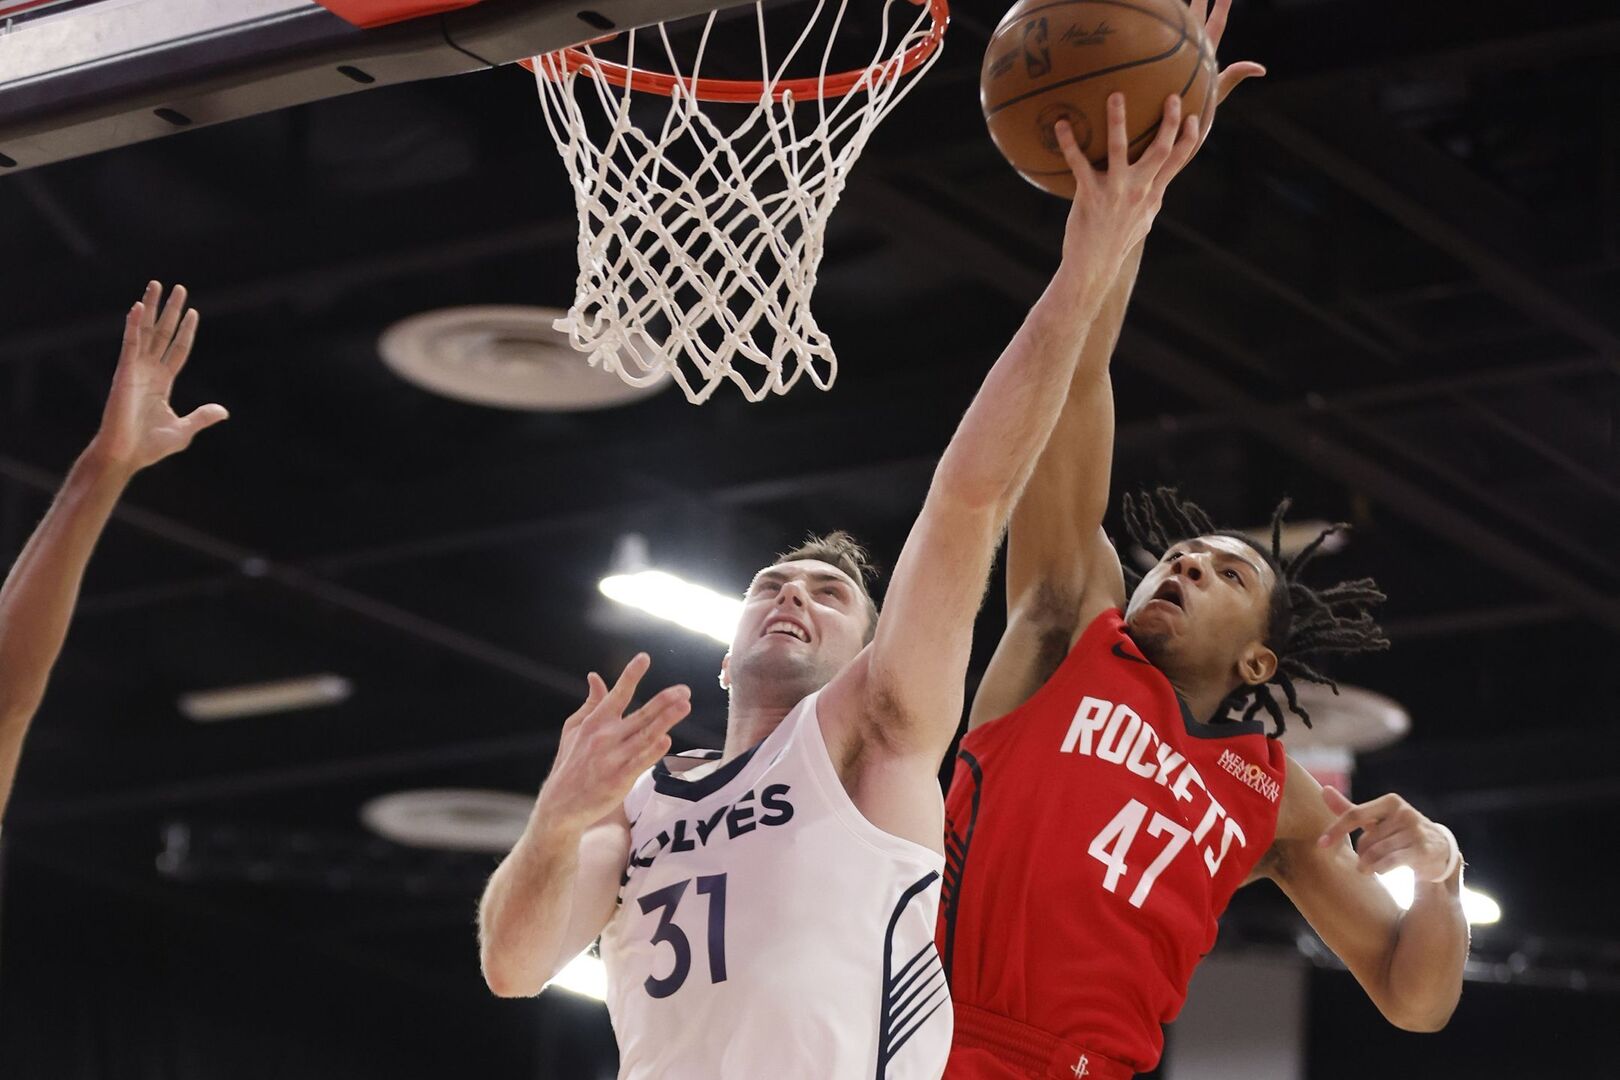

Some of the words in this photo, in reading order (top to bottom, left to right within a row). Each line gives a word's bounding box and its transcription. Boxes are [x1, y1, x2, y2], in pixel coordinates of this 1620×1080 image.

[1060, 696, 1246, 877] ROCKETS
[1217, 757, 1279, 803] HERMANN
[1218, 749, 1280, 794] MEMORIAL
[617, 783, 794, 904] OLVES
[1087, 798, 1192, 908] 47
[637, 872, 727, 998] 31
